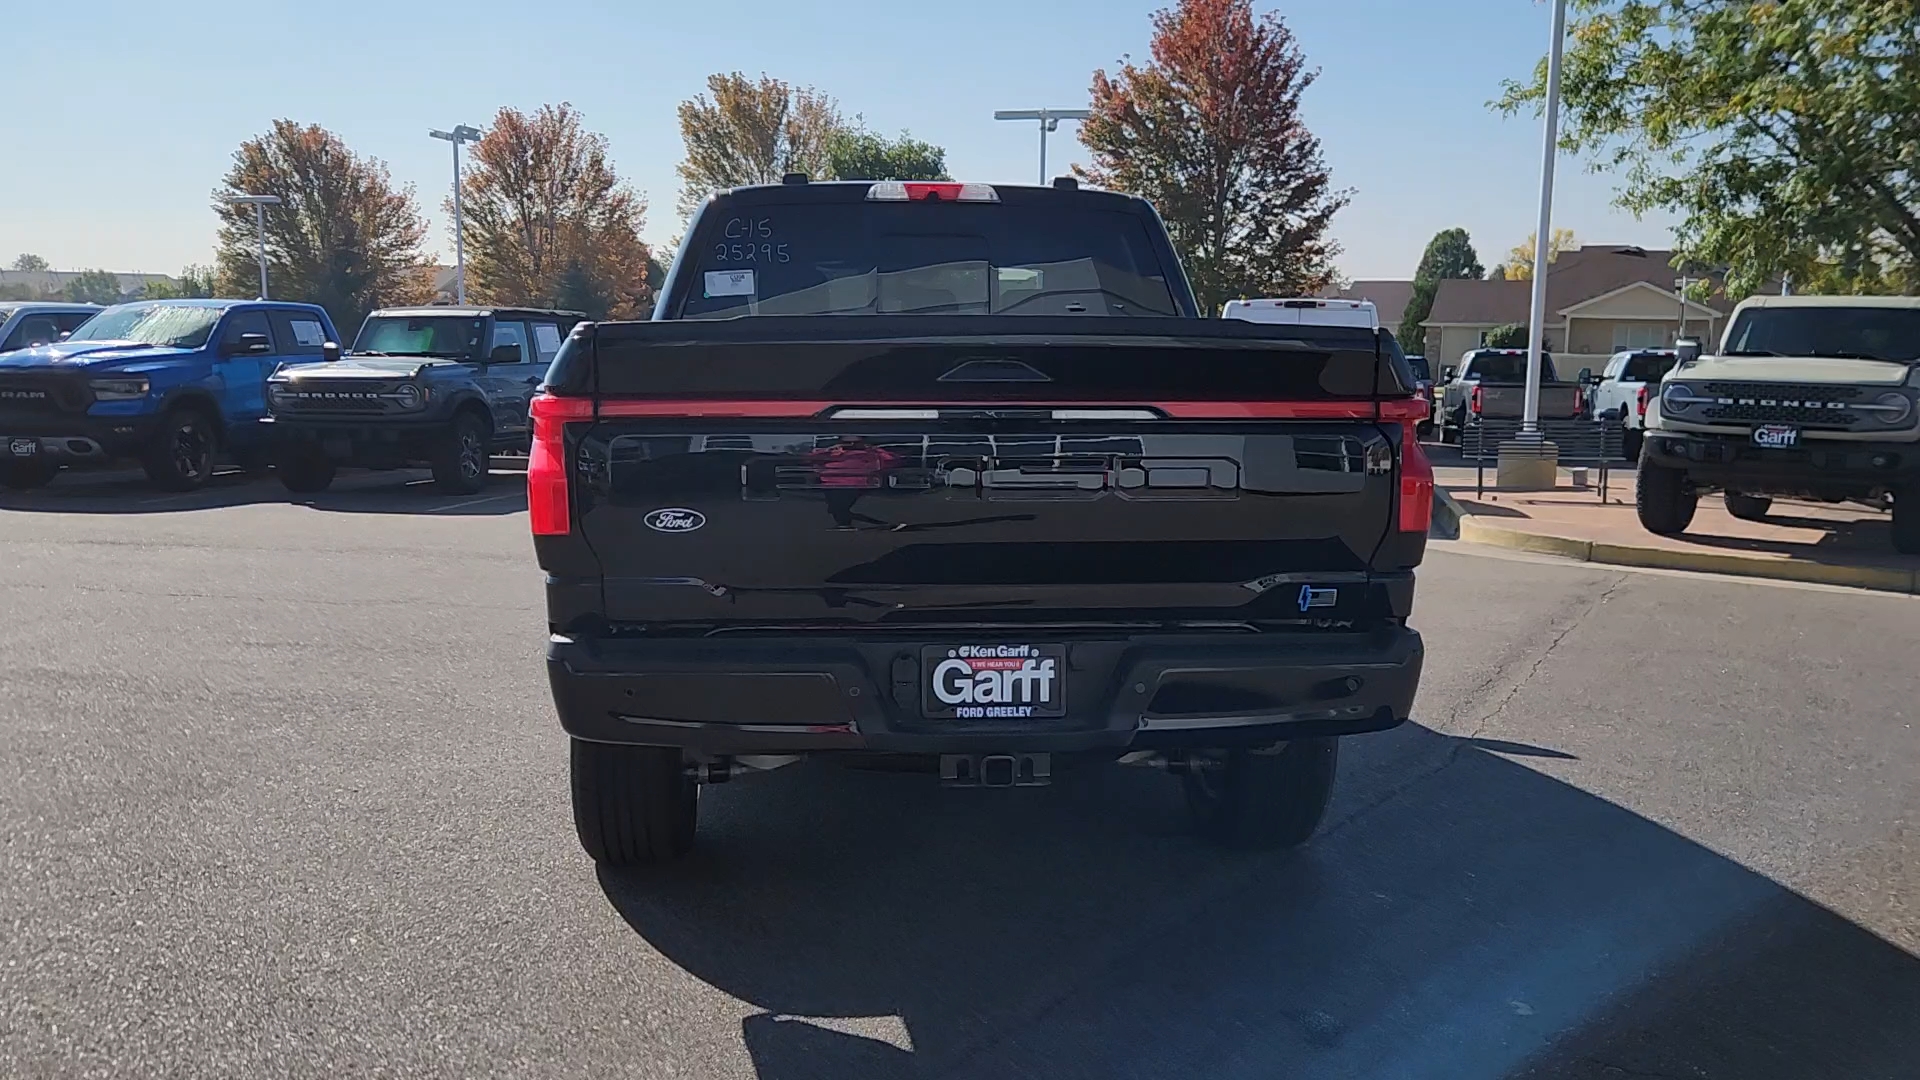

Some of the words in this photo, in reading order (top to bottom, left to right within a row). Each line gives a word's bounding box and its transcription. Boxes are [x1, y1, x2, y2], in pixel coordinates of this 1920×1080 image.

[724, 217, 772, 239] C-15
[715, 243, 790, 263] 25295
[1, 391, 46, 399] RAM
[1717, 397, 1845, 409] BRONCO
[1754, 428, 1797, 445] Garff
[10, 442, 37, 453] Garff
[655, 511, 695, 528] Ford
[970, 645, 996, 658] Ken
[996, 644, 1030, 658] Garff
[932, 658, 1056, 705] Garff
[956, 706, 984, 718] FORD
[985, 706, 1033, 718] GREELEY
